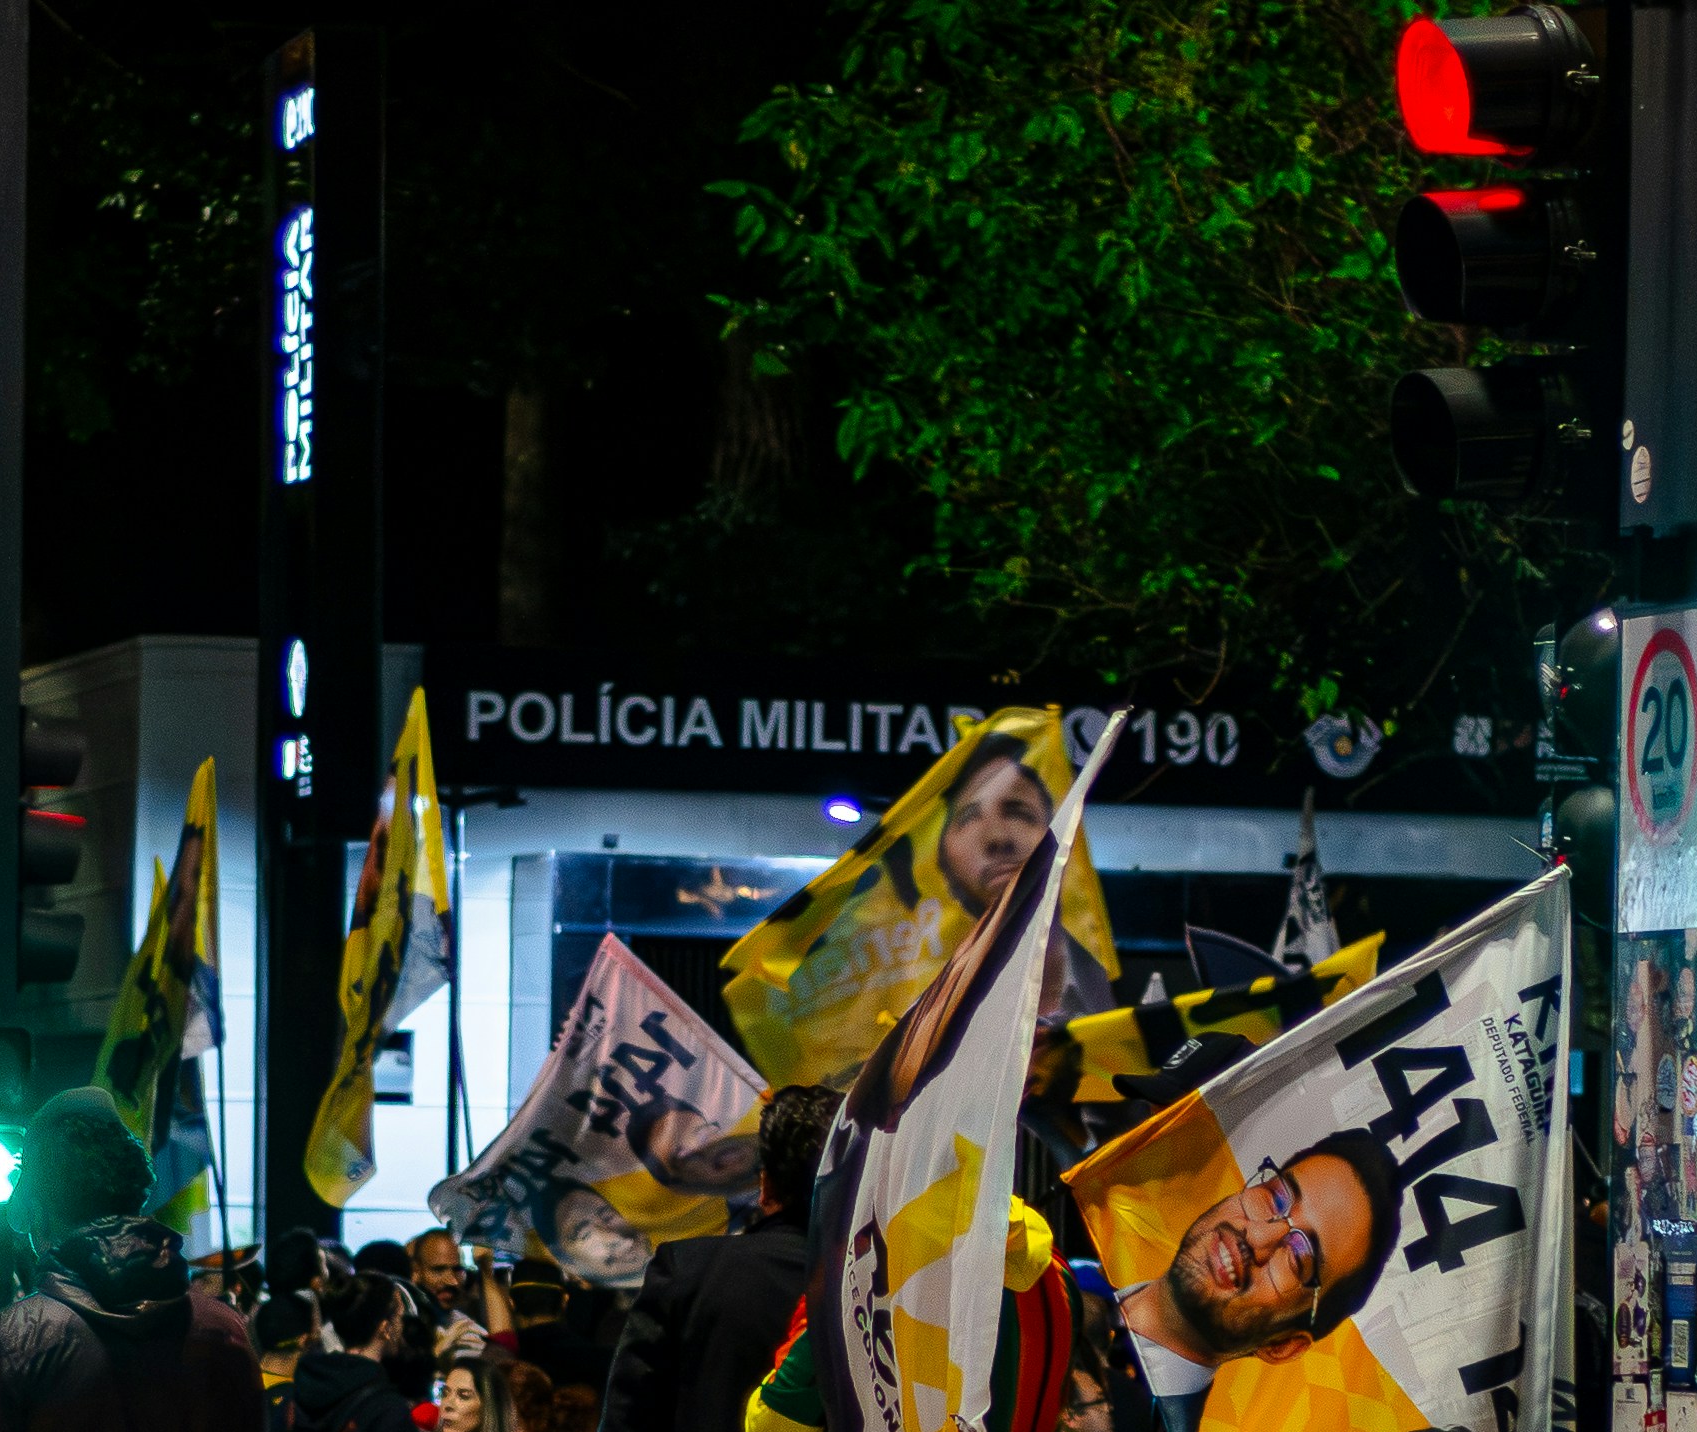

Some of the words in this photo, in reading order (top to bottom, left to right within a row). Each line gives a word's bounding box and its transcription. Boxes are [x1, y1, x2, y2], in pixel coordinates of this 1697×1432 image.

[282, 221, 301, 484] POLÍCIA
[466, 684, 723, 749] POLÍCIA
[1131, 708, 1240, 767] 190
[1640, 679, 1689, 775] 20
[1335, 969, 1527, 1274] 1414
[1481, 1015, 1515, 1085] DEPUTADO
[1507, 1085, 1534, 1145] FEDERAL
